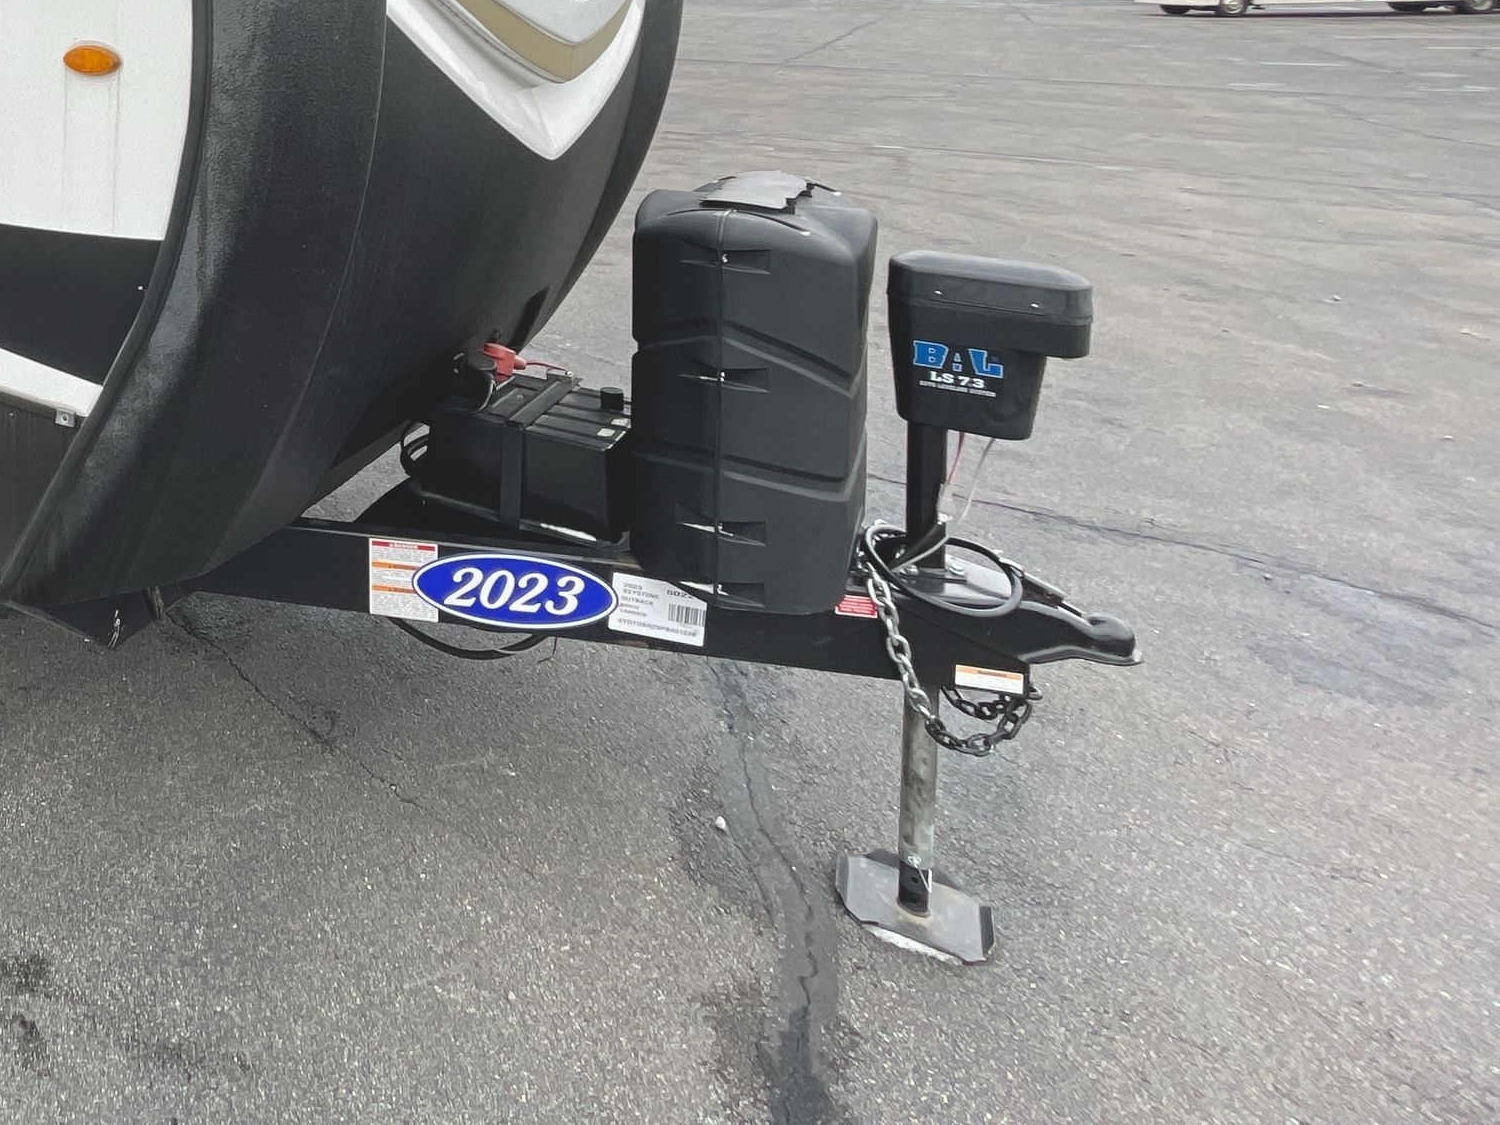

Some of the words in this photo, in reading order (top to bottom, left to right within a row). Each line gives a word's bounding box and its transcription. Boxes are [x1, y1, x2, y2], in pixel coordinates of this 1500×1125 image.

[930, 370, 955, 384] LS
[958, 375, 985, 388] 73
[443, 567, 586, 616] 2023
[623, 589, 660, 599] KEYSTONE
[621, 595, 654, 606] OUTBACK
